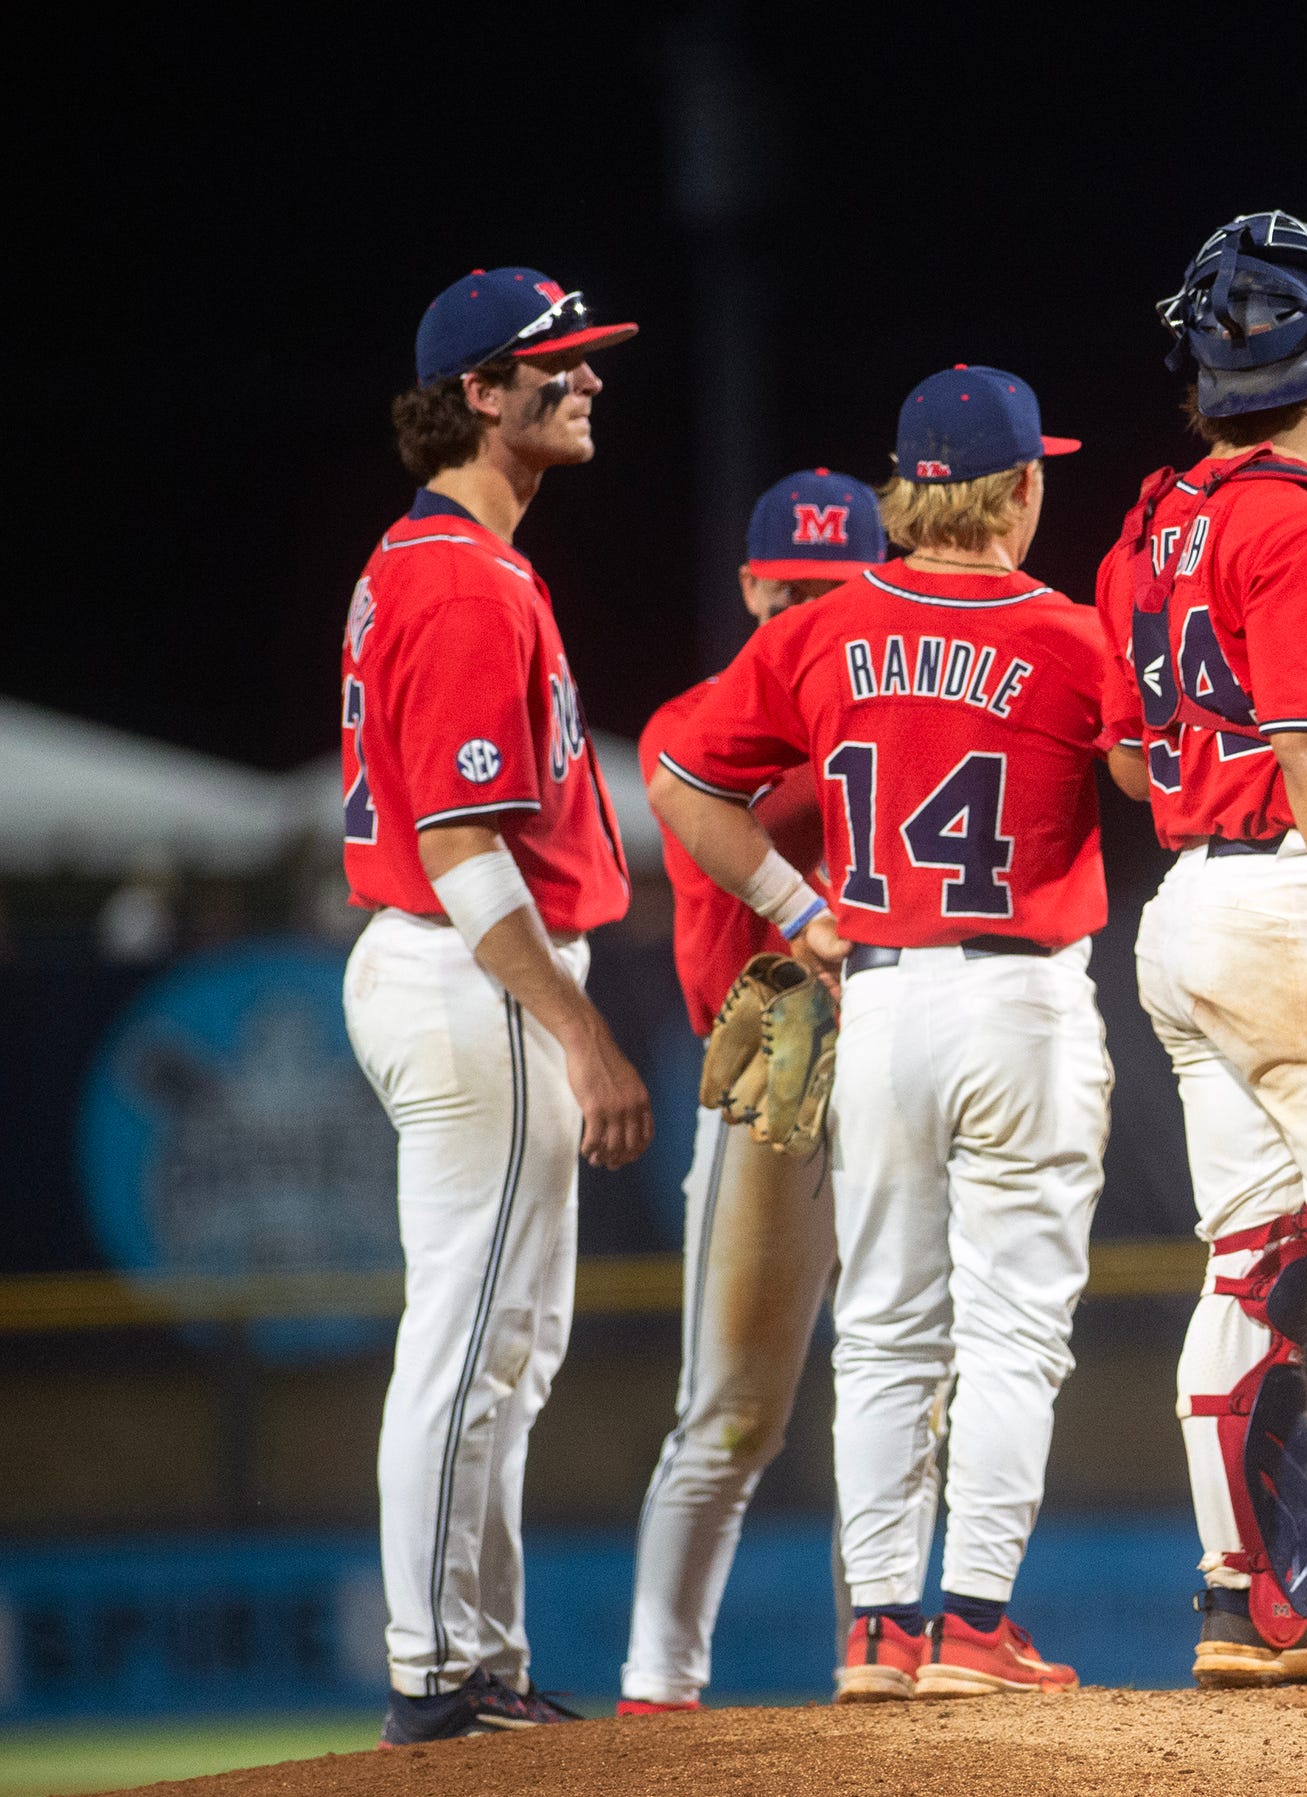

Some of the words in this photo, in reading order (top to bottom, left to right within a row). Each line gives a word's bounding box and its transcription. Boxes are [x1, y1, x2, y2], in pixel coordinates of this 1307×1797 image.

[792, 504, 850, 547] M
[845, 635, 1034, 719] RANDLE
[458, 739, 499, 782] SEC
[824, 740, 1015, 919] 14
